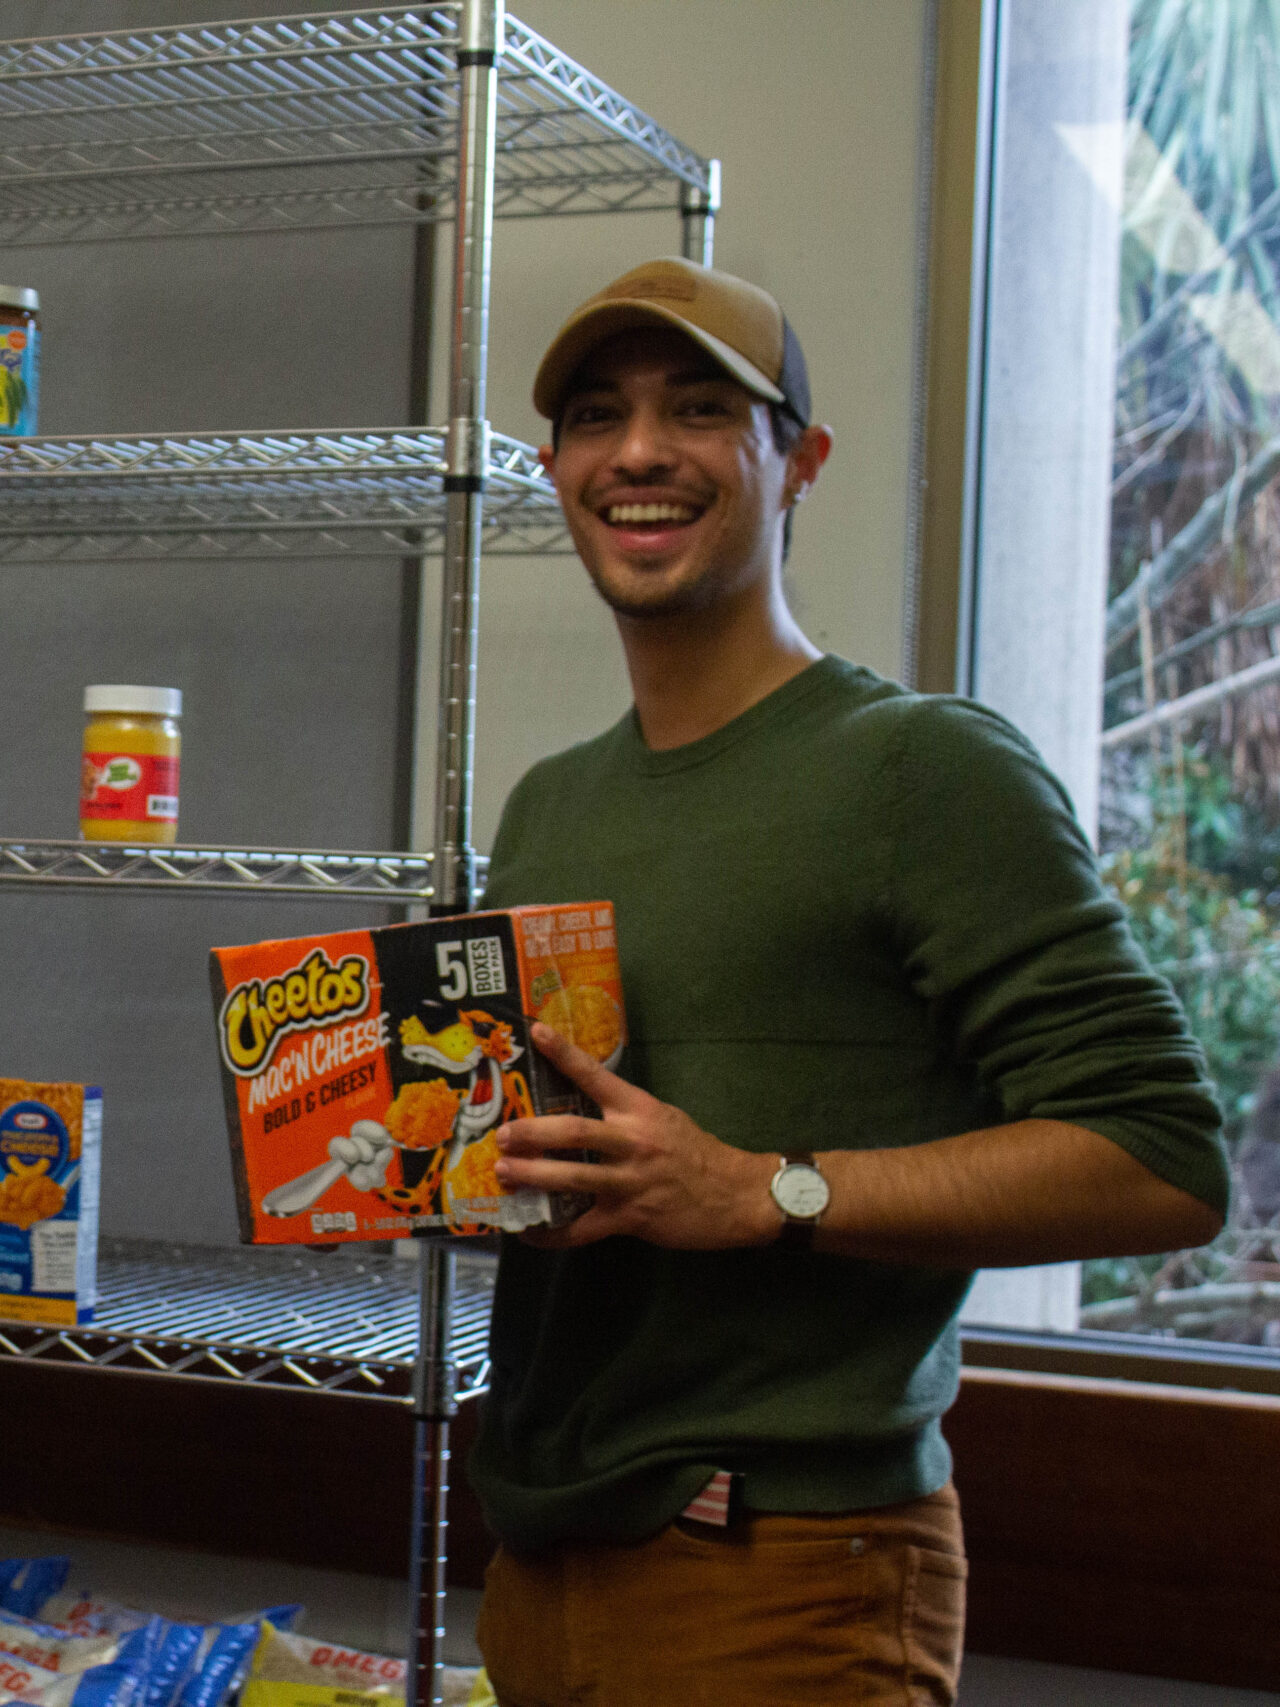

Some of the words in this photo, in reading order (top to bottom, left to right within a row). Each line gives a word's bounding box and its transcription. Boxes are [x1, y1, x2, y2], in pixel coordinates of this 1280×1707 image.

[436, 940, 468, 1000] 5
[471, 940, 491, 993] BOXES
[489, 939, 500, 967] PACK
[494, 968, 502, 991] PER
[221, 950, 367, 1073] Cheetos
[311, 1011, 392, 1076] CHEESE
[263, 1097, 301, 1135] BOLD
[304, 1090, 317, 1114] &
[320, 1059, 378, 1107] CHEESY
[309, 1646, 402, 1679] OMEG
